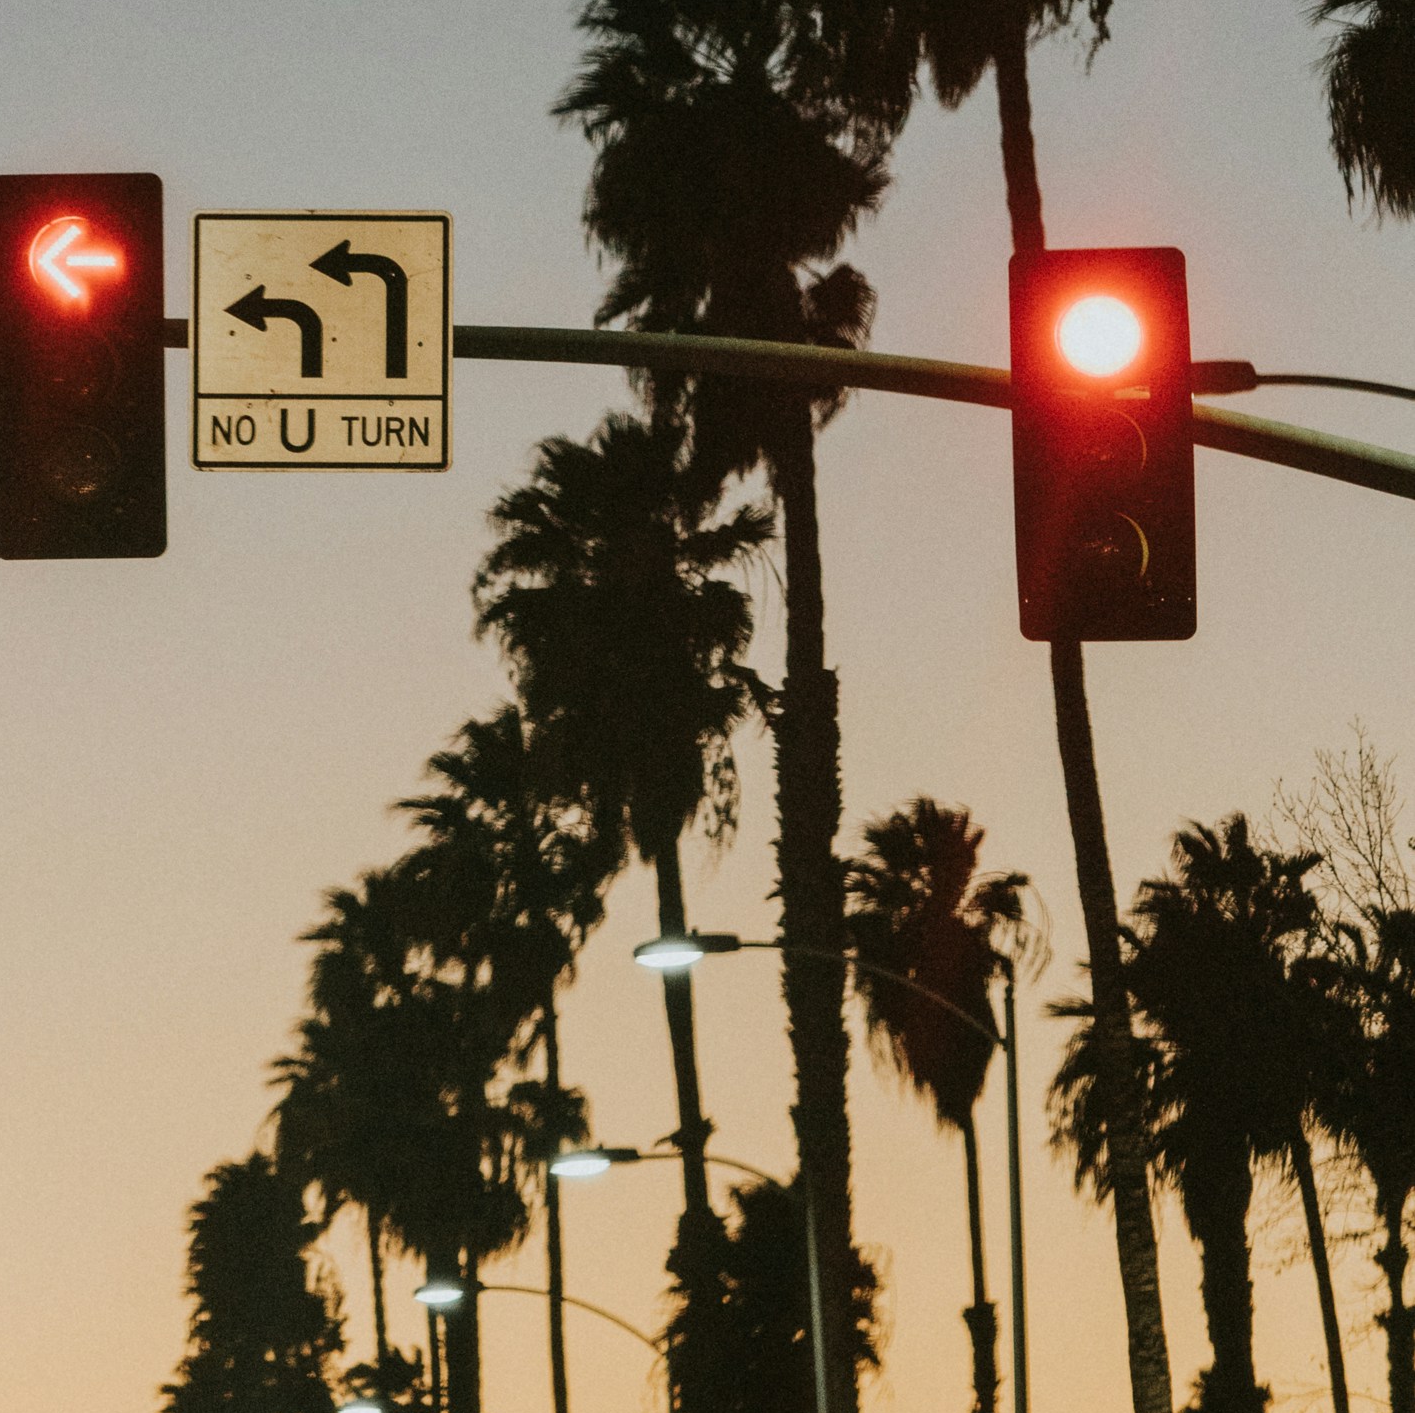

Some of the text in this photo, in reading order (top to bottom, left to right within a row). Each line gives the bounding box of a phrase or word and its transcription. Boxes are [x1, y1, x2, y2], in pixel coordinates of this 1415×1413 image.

[211, 408, 430, 453] NO U TURN
